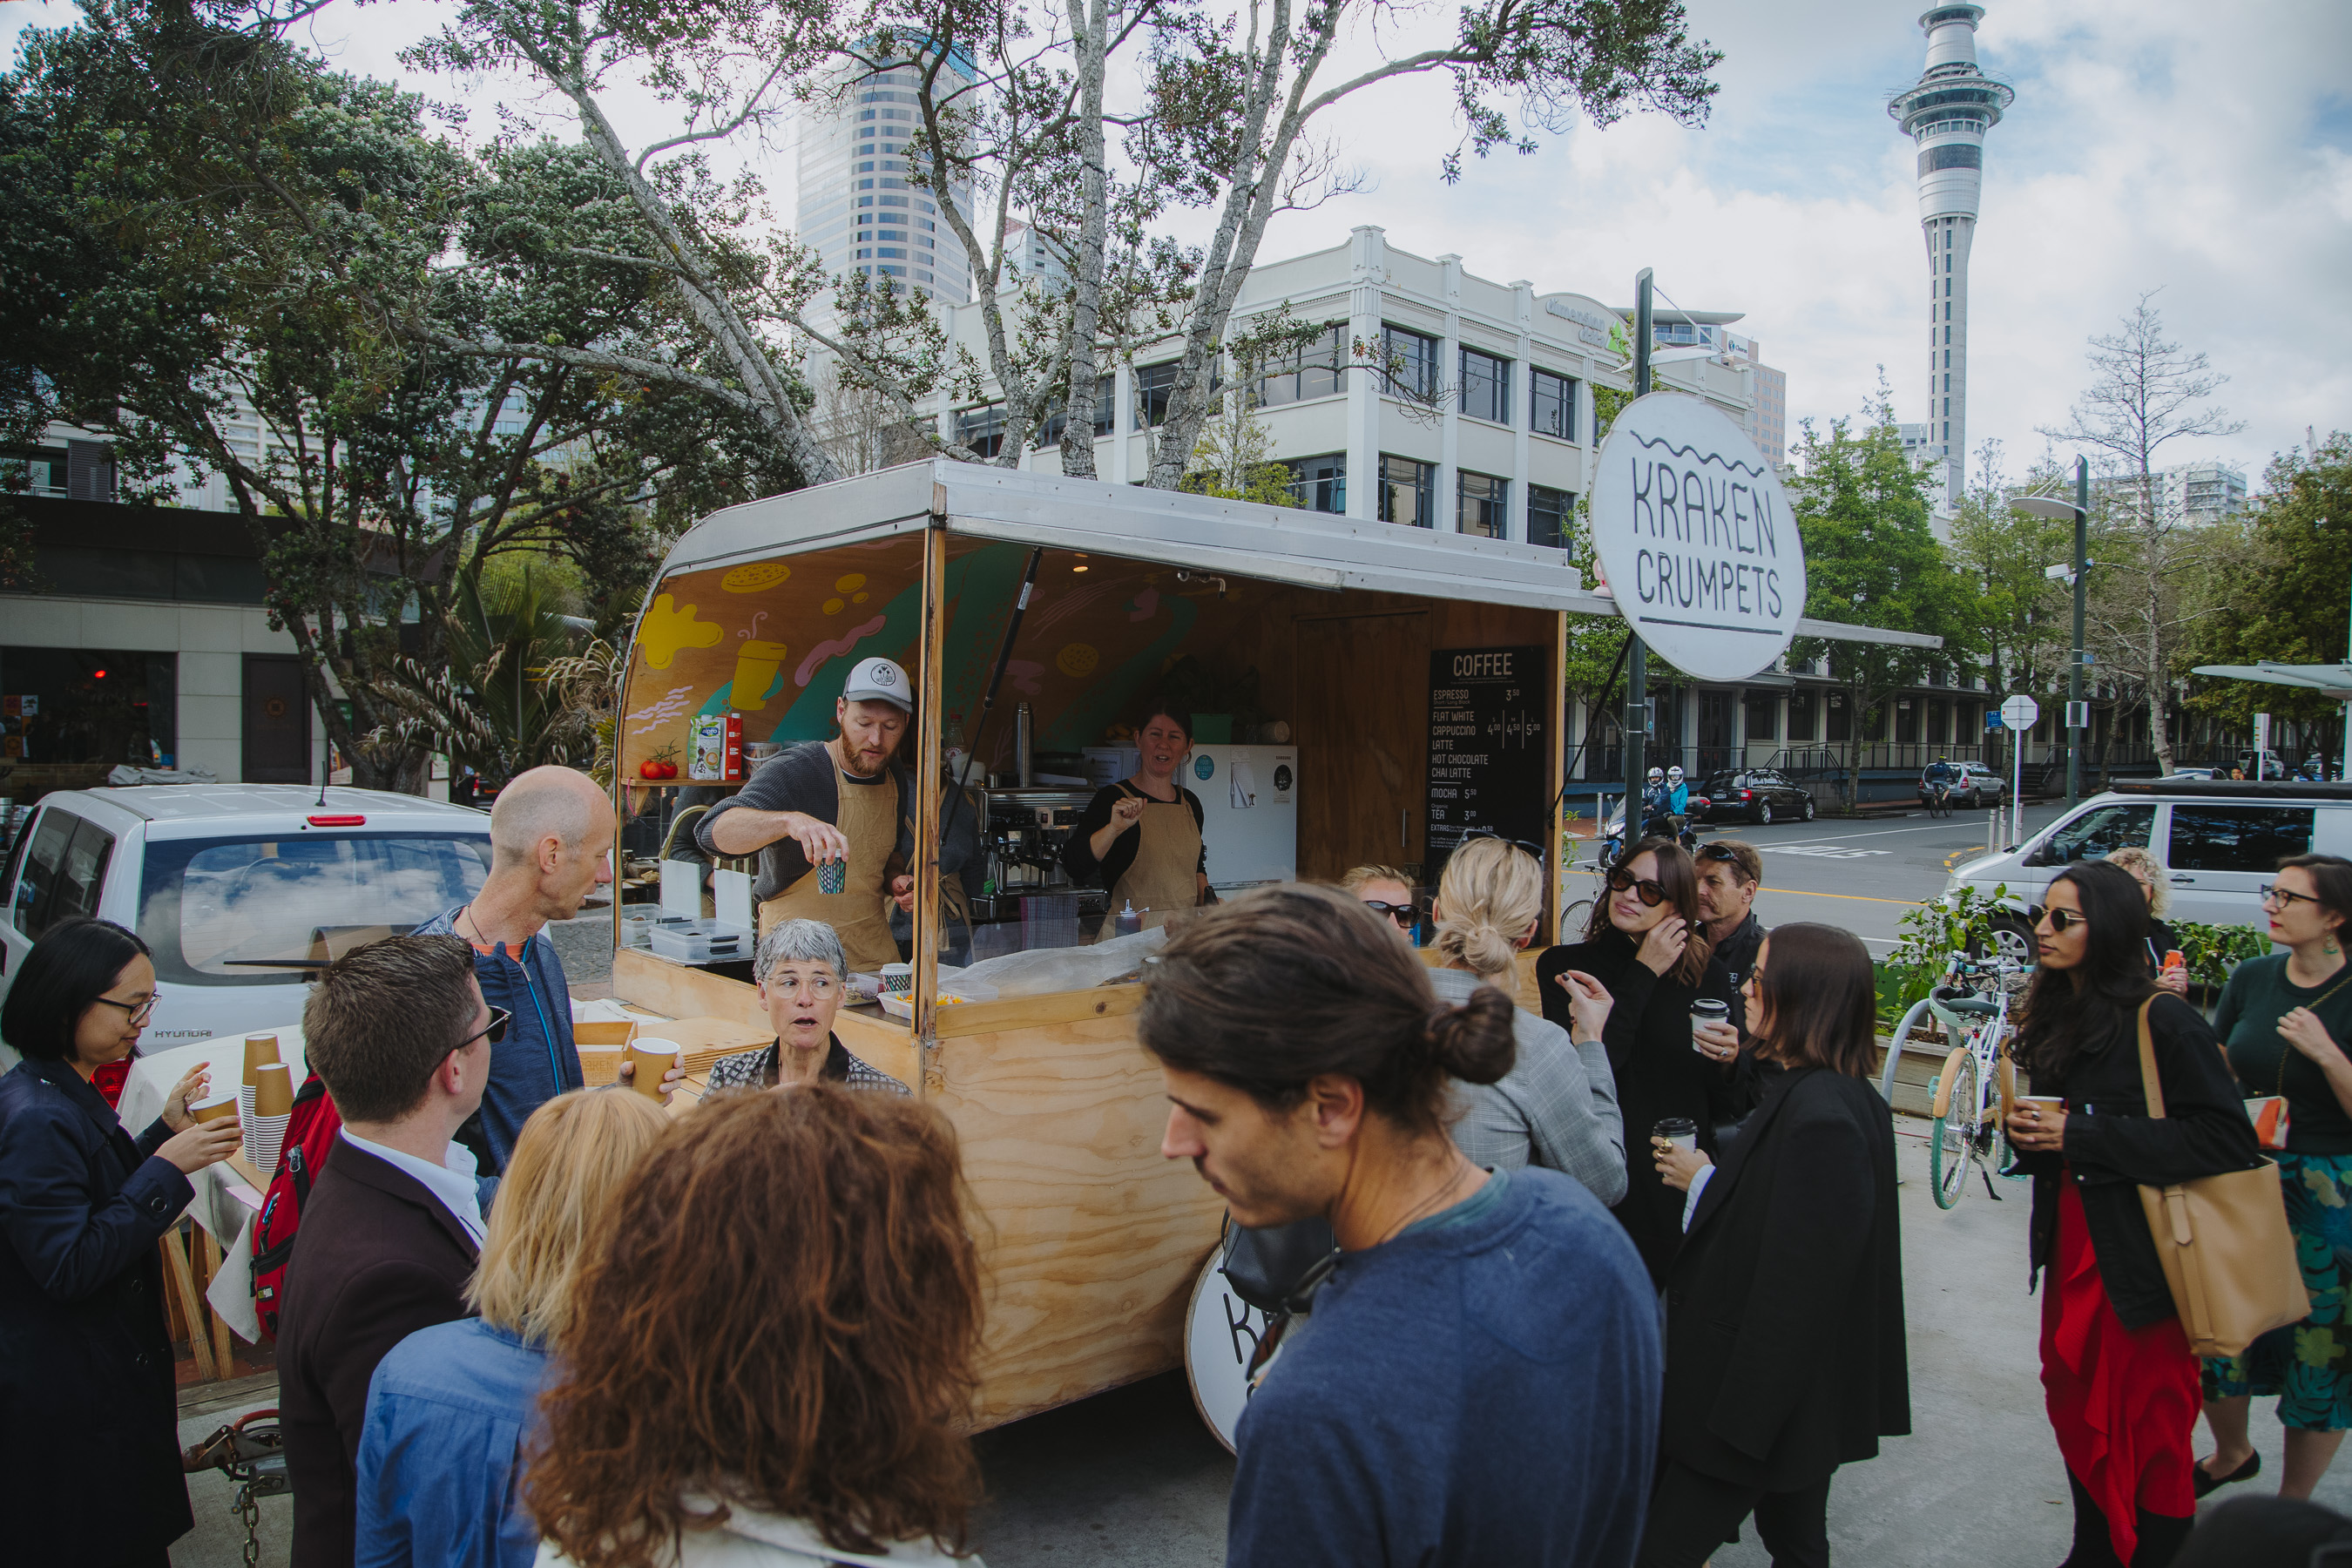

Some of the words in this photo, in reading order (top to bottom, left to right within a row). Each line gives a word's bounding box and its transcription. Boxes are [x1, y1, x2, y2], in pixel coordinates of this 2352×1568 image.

[1545, 298, 1605, 332] dimension
[1578, 326, 1605, 348] data
[1632, 456, 1776, 558] KRAKEN
[1638, 549, 1782, 618] CRUMPETS
[1453, 652, 1513, 677] COFFEE
[1433, 689, 1470, 700] ESPRESSO
[1433, 711, 1450, 721] FLAT
[1451, 711, 1475, 721] WHITE
[1432, 726, 1476, 736] CAPPUCCINO
[1432, 740, 1454, 750] LATTE
[1432, 754, 1446, 764] HOT
[1448, 754, 1489, 765] CHOCOLATE
[1431, 767, 1448, 778] CHAI
[1450, 767, 1471, 778] LATTE
[1431, 787, 1457, 799] MOCHA
[1431, 809, 1445, 820] TEA
[154, 1029, 213, 1038] HYUNDAI
